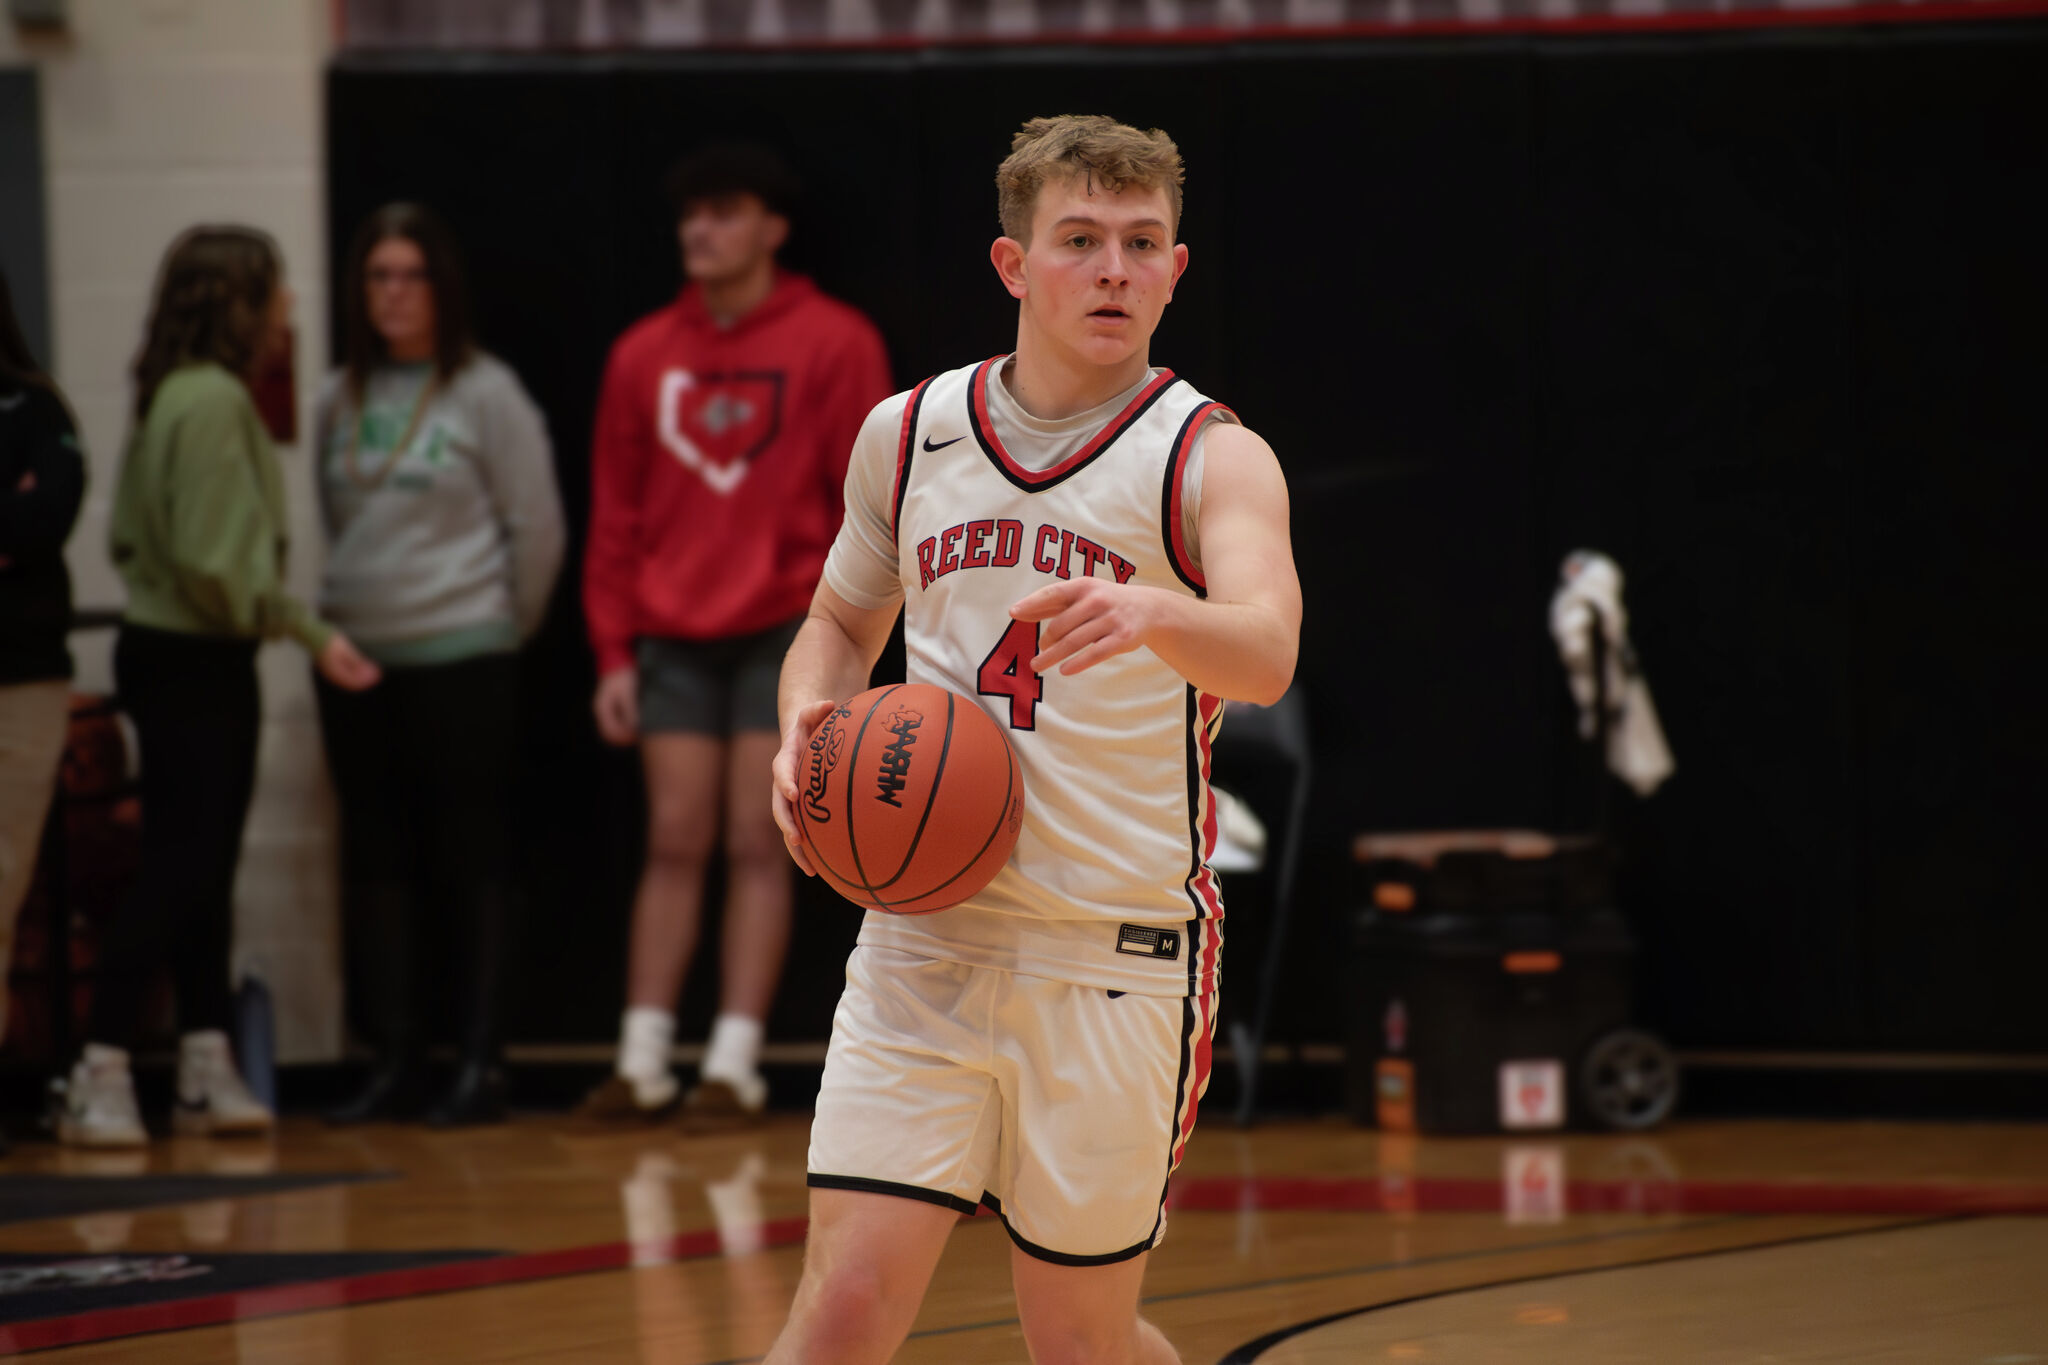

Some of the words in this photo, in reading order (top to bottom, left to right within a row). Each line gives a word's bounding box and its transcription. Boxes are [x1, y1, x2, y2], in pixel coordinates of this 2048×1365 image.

[917, 519, 1024, 592] REED
[1032, 523, 1136, 584] CITY
[977, 618, 1043, 732] 4
[1162, 939, 1173, 952] M
